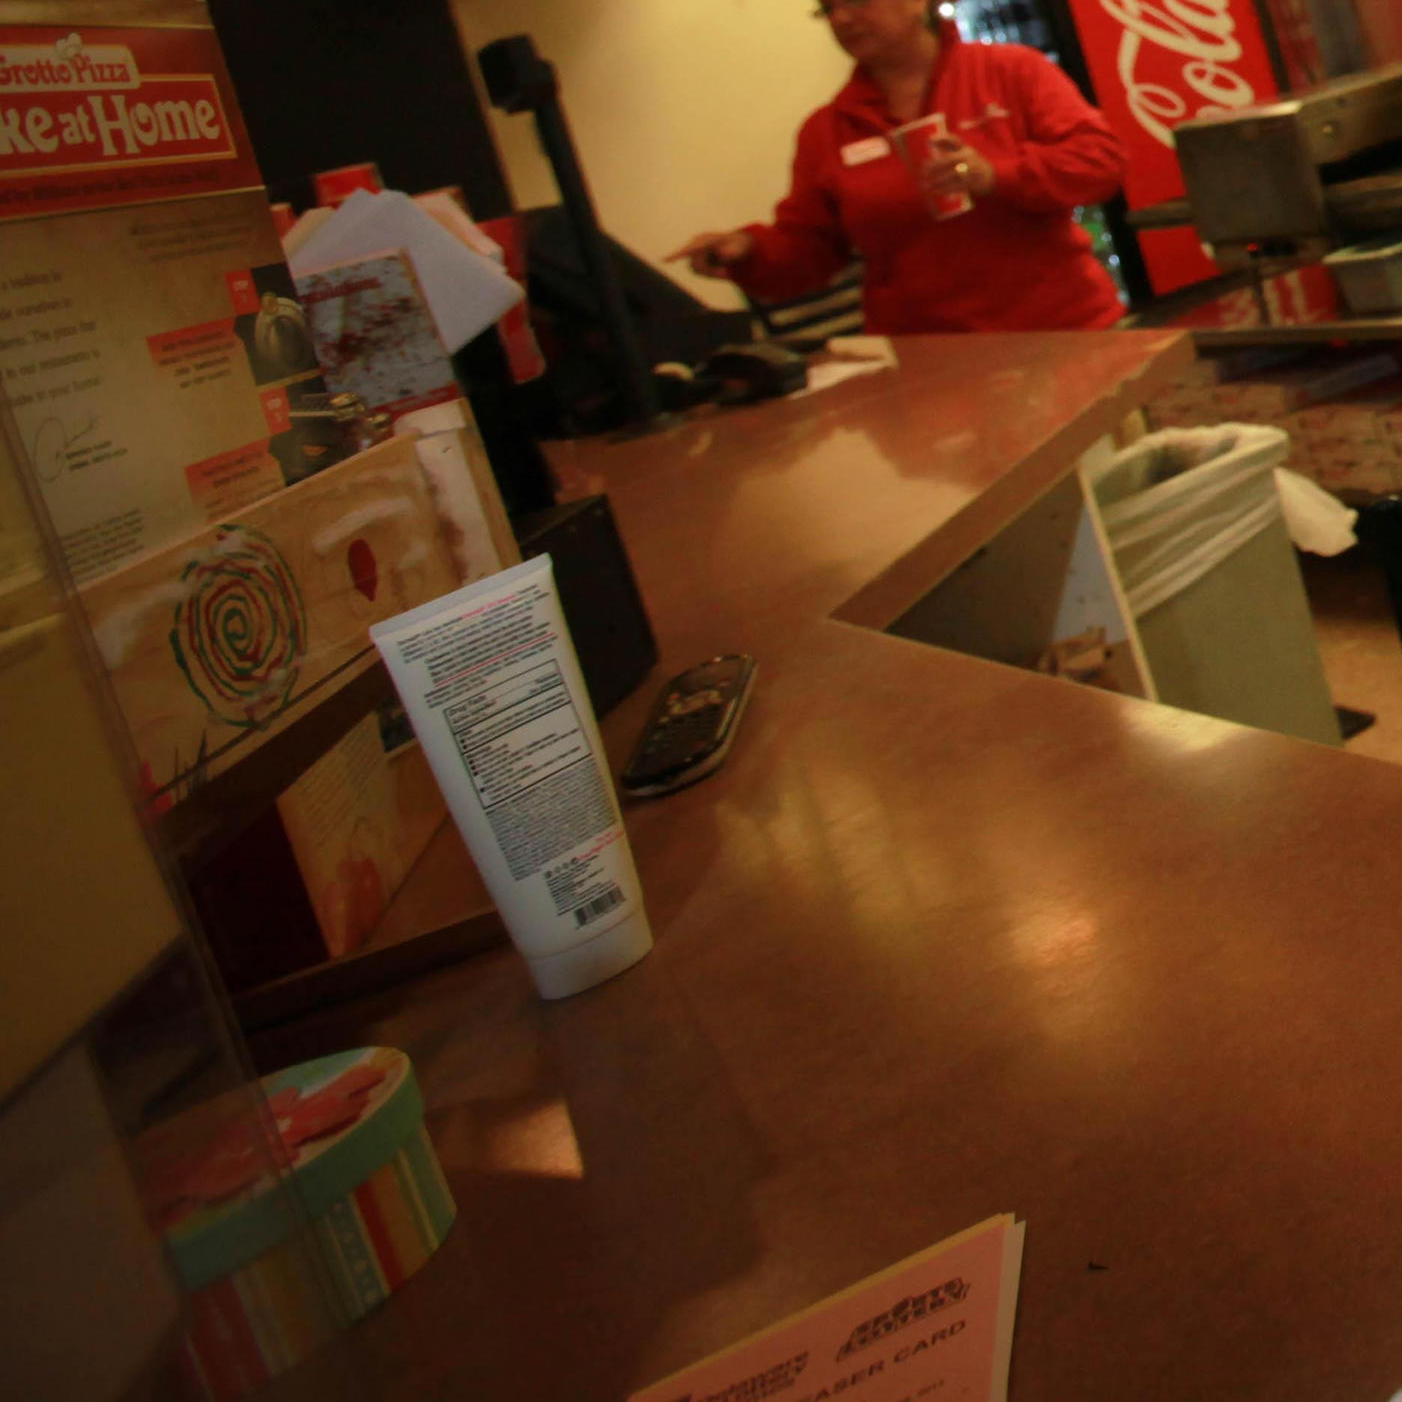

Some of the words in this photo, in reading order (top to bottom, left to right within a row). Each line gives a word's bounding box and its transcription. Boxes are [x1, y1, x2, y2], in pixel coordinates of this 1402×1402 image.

[71, 52, 132, 84] Pizza
[58, 104, 96, 146] at
[87, 95, 221, 157] Home
[797, 1359, 885, 1402] ASER
[893, 1320, 966, 1364] CARD
